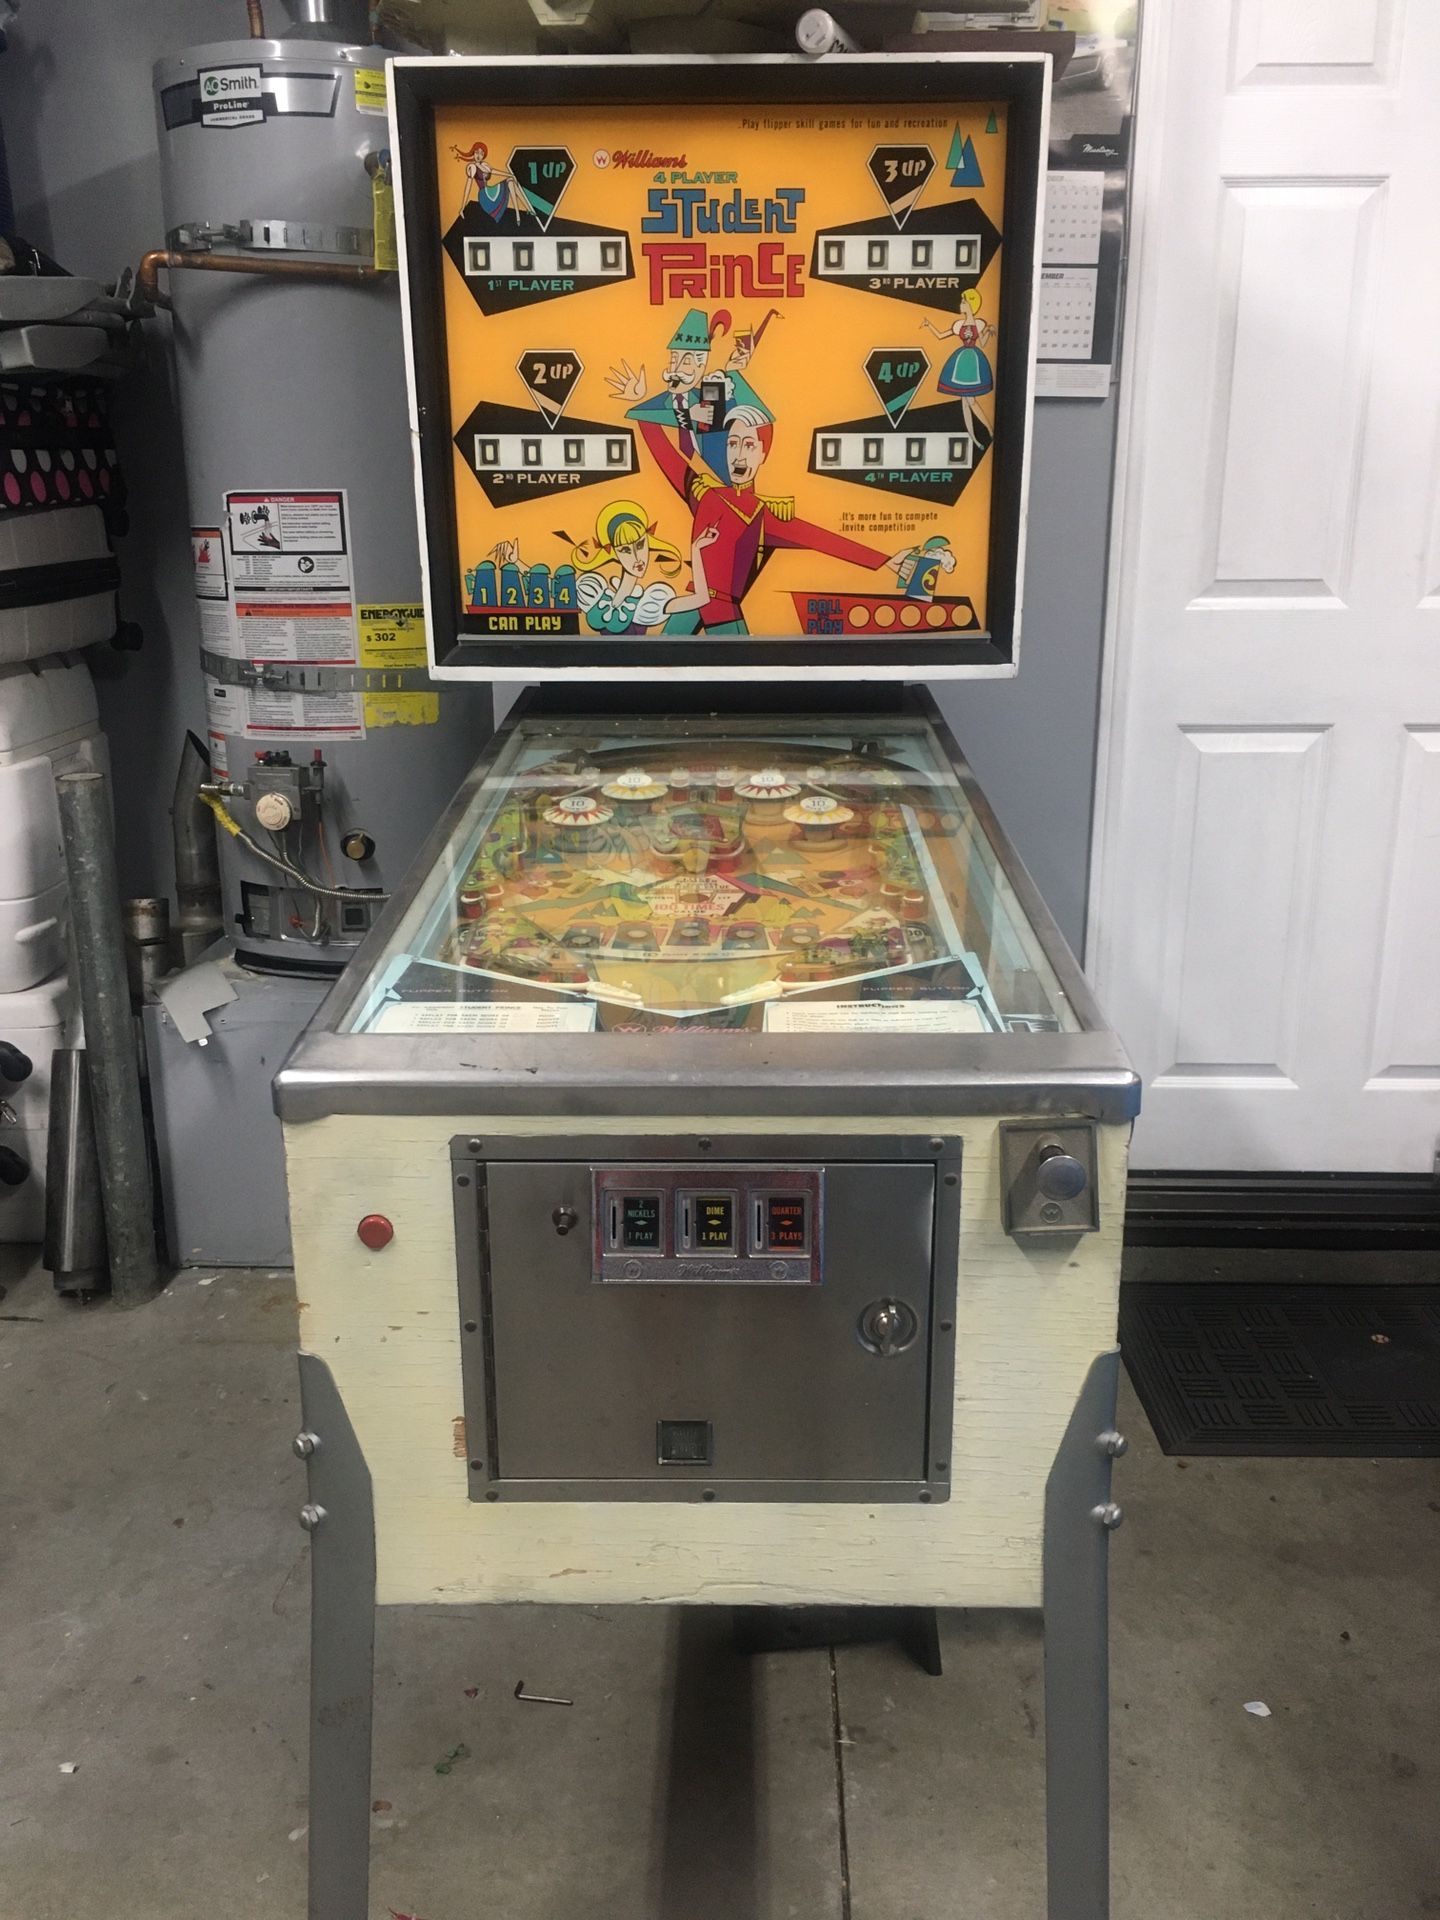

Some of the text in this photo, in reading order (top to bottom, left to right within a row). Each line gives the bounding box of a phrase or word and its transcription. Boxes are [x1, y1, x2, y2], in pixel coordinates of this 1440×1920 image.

[220, 76, 257, 92] Smith
[213, 101, 248, 110] ProLine
[763, 119, 791, 131] flipper
[795, 119, 815, 130] skill
[819, 119, 846, 131] games
[851, 119, 863, 129] for
[867, 119, 881, 129] fun
[884, 119, 899, 129] and
[903, 119, 948, 129] recreation
[612, 150, 688, 169] Williams
[528, 161, 566, 184] 1 UP
[884, 159, 927, 183] 3 UP
[653, 171, 738, 184] 4 PLAYER
[508, 280, 575, 291] PLAYER
[894, 278, 960, 289] PLAYER
[532, 363, 573, 384] 2 UP
[878, 361, 921, 383] 4 UP
[517, 473, 580, 484] PLAYER
[889, 472, 953, 483] PLAYER
[858, 513, 876, 521] more
[880, 512, 892, 521] fun
[895, 512, 904, 521] to
[906, 513, 938, 522] compete
[869, 523, 916, 532] competition
[480, 587, 570, 605] 1 2 3 4
[488, 616, 562, 631] CAN PLAY
[808, 618, 843, 635] PLAY
[375, 633, 396, 642] 302
[682, 902, 725, 911] TIMES
[627, 1208, 655, 1218] NICKELS
[706, 1206, 725, 1215] DIME
[771, 1206, 802, 1215] QUARTER
[635, 1232, 653, 1240] PLAY
[709, 1231, 727, 1241] PLAY
[779, 1232, 802, 1240] PLAYS
